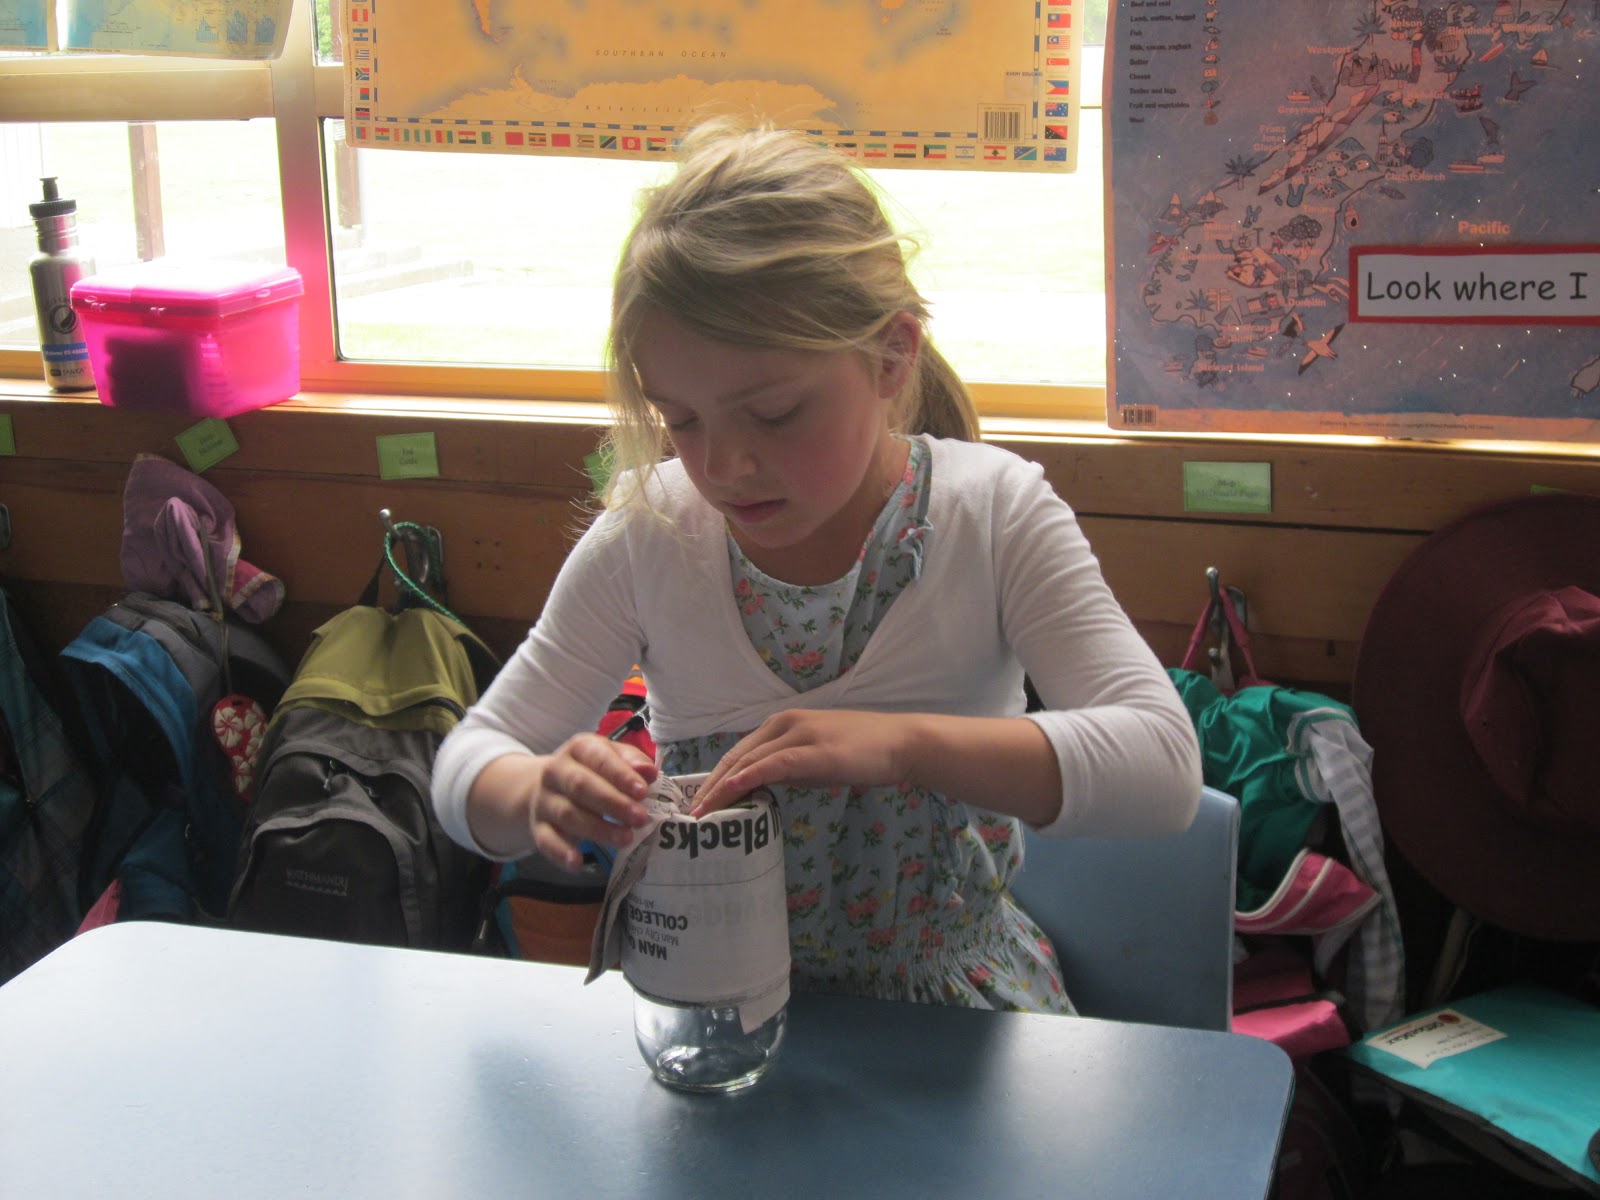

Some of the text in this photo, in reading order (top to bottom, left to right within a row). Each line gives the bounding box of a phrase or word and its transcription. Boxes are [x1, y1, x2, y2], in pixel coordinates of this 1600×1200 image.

[1389, 19, 1422, 28] Nelson
[594, 49, 727, 58] SOUTHERN OCEAN
[1307, 45, 1352, 55] Westport
[1278, 105, 1330, 115] Greymouth
[1259, 125, 1286, 133] Franz
[1458, 220, 1511, 236] Pacific
[1367, 271, 1588, 300] Look where I
[1237, 363, 1265, 372] Island
[658, 811, 769, 860] Blacks
[630, 904, 688, 931] COLLEGE
[638, 939, 667, 961] MAN
